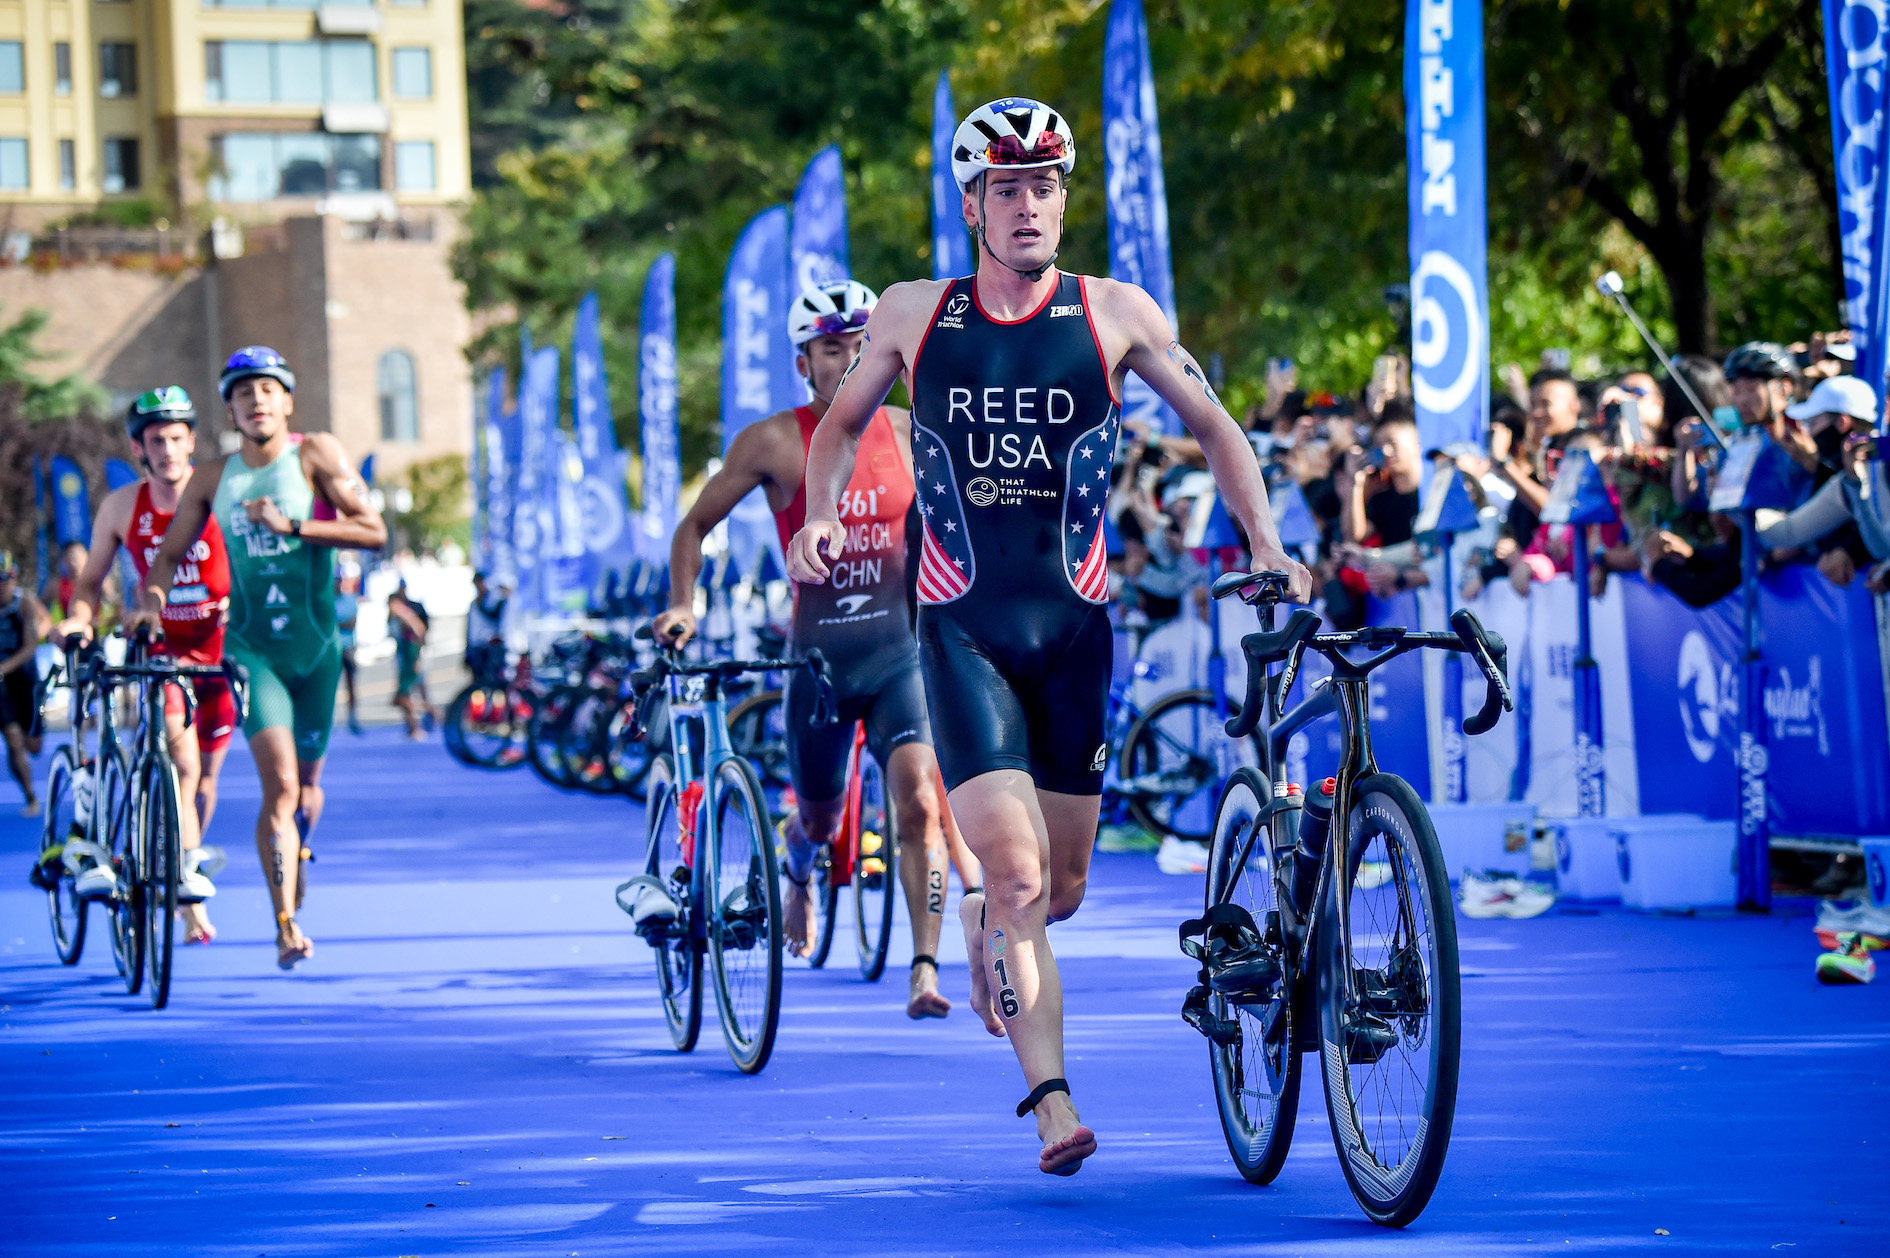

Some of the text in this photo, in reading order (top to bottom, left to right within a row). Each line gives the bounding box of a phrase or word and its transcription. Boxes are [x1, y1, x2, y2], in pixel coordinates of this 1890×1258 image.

[999, 100, 1014, 108] 16
[937, 321, 965, 330] Triathlon
[947, 387, 1075, 424] REED
[967, 433, 1053, 470] USA
[999, 478, 1025, 486] THAT
[1000, 488, 1058, 498] TRIATHLON
[1000, 497, 1022, 505] LIFE
[173, 563, 201, 585] UI
[832, 557, 882, 590] CHN
[1316, 633, 1353, 642] cervélo
[1365, 806, 1410, 850] CARBONWORKS
[929, 870, 942, 913] 32
[993, 957, 1020, 1019] 16
